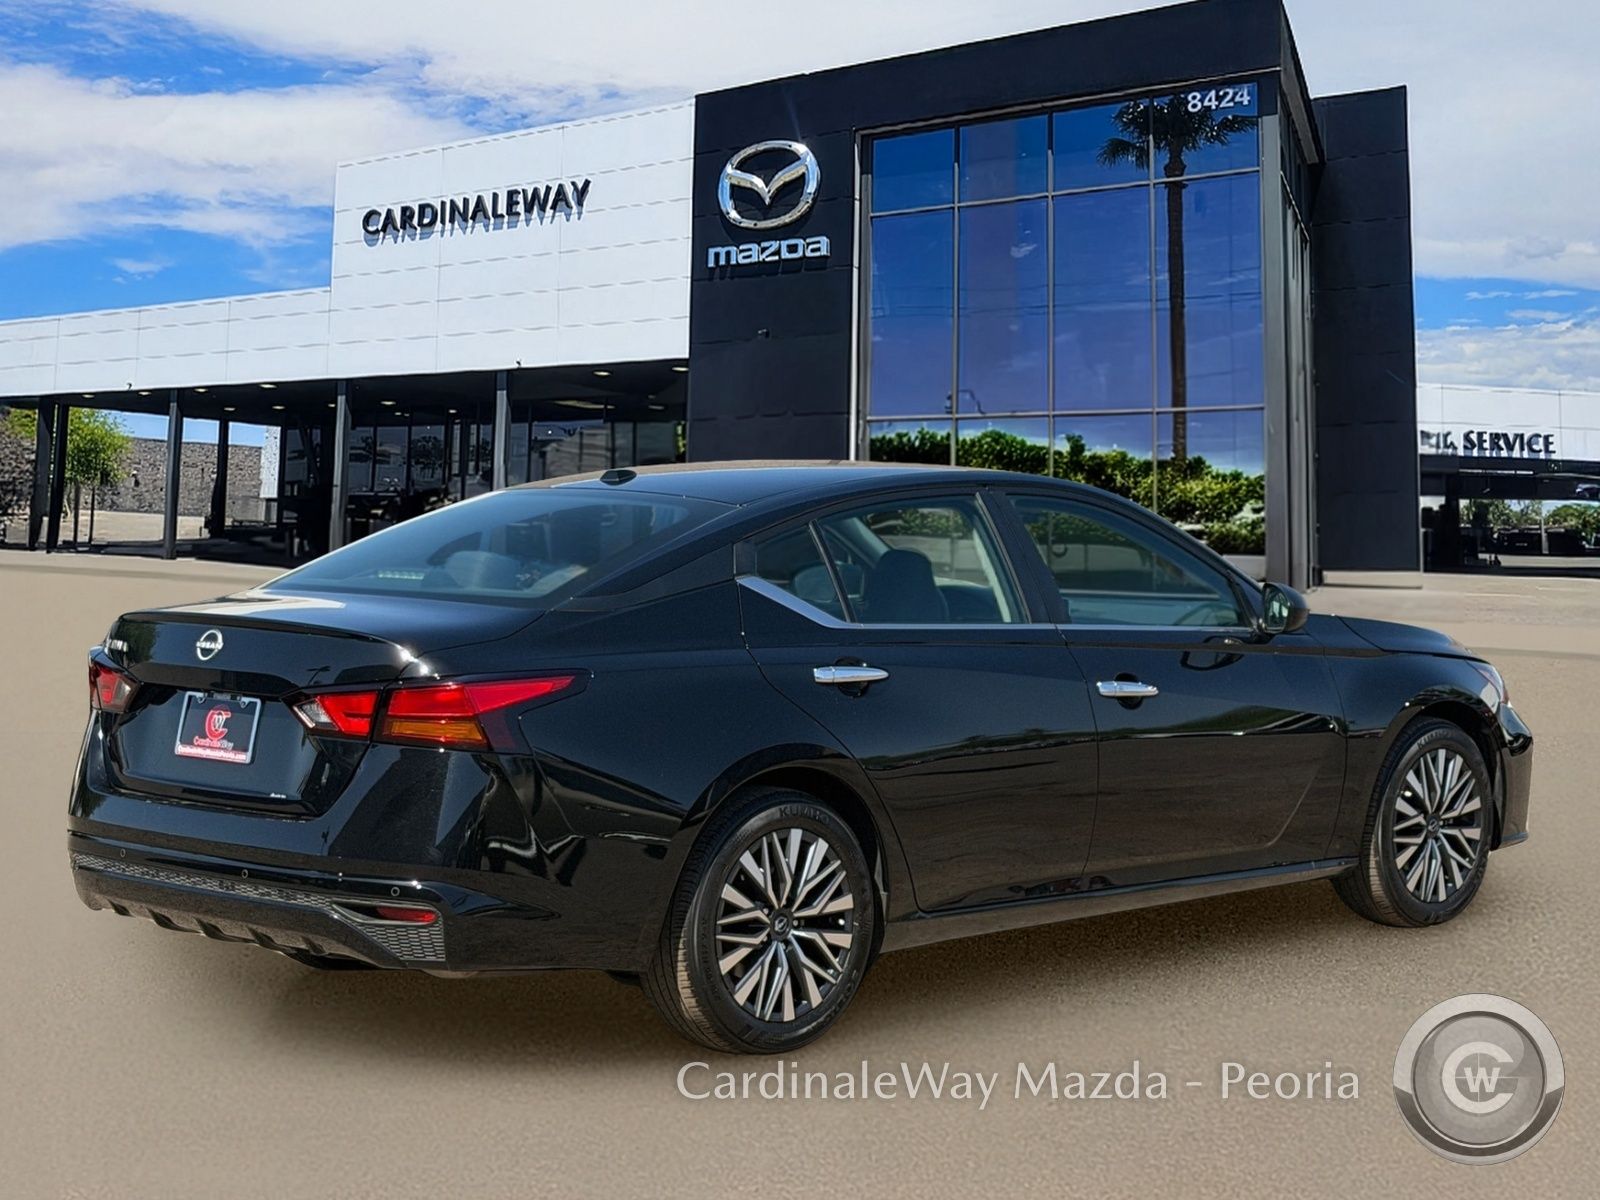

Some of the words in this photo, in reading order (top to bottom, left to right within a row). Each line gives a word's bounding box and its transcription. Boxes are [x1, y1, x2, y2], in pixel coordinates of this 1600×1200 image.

[1187, 86, 1251, 113] 8424
[362, 179, 592, 235] CARDINALEWAY
[1463, 430, 1556, 454] SERVICE
